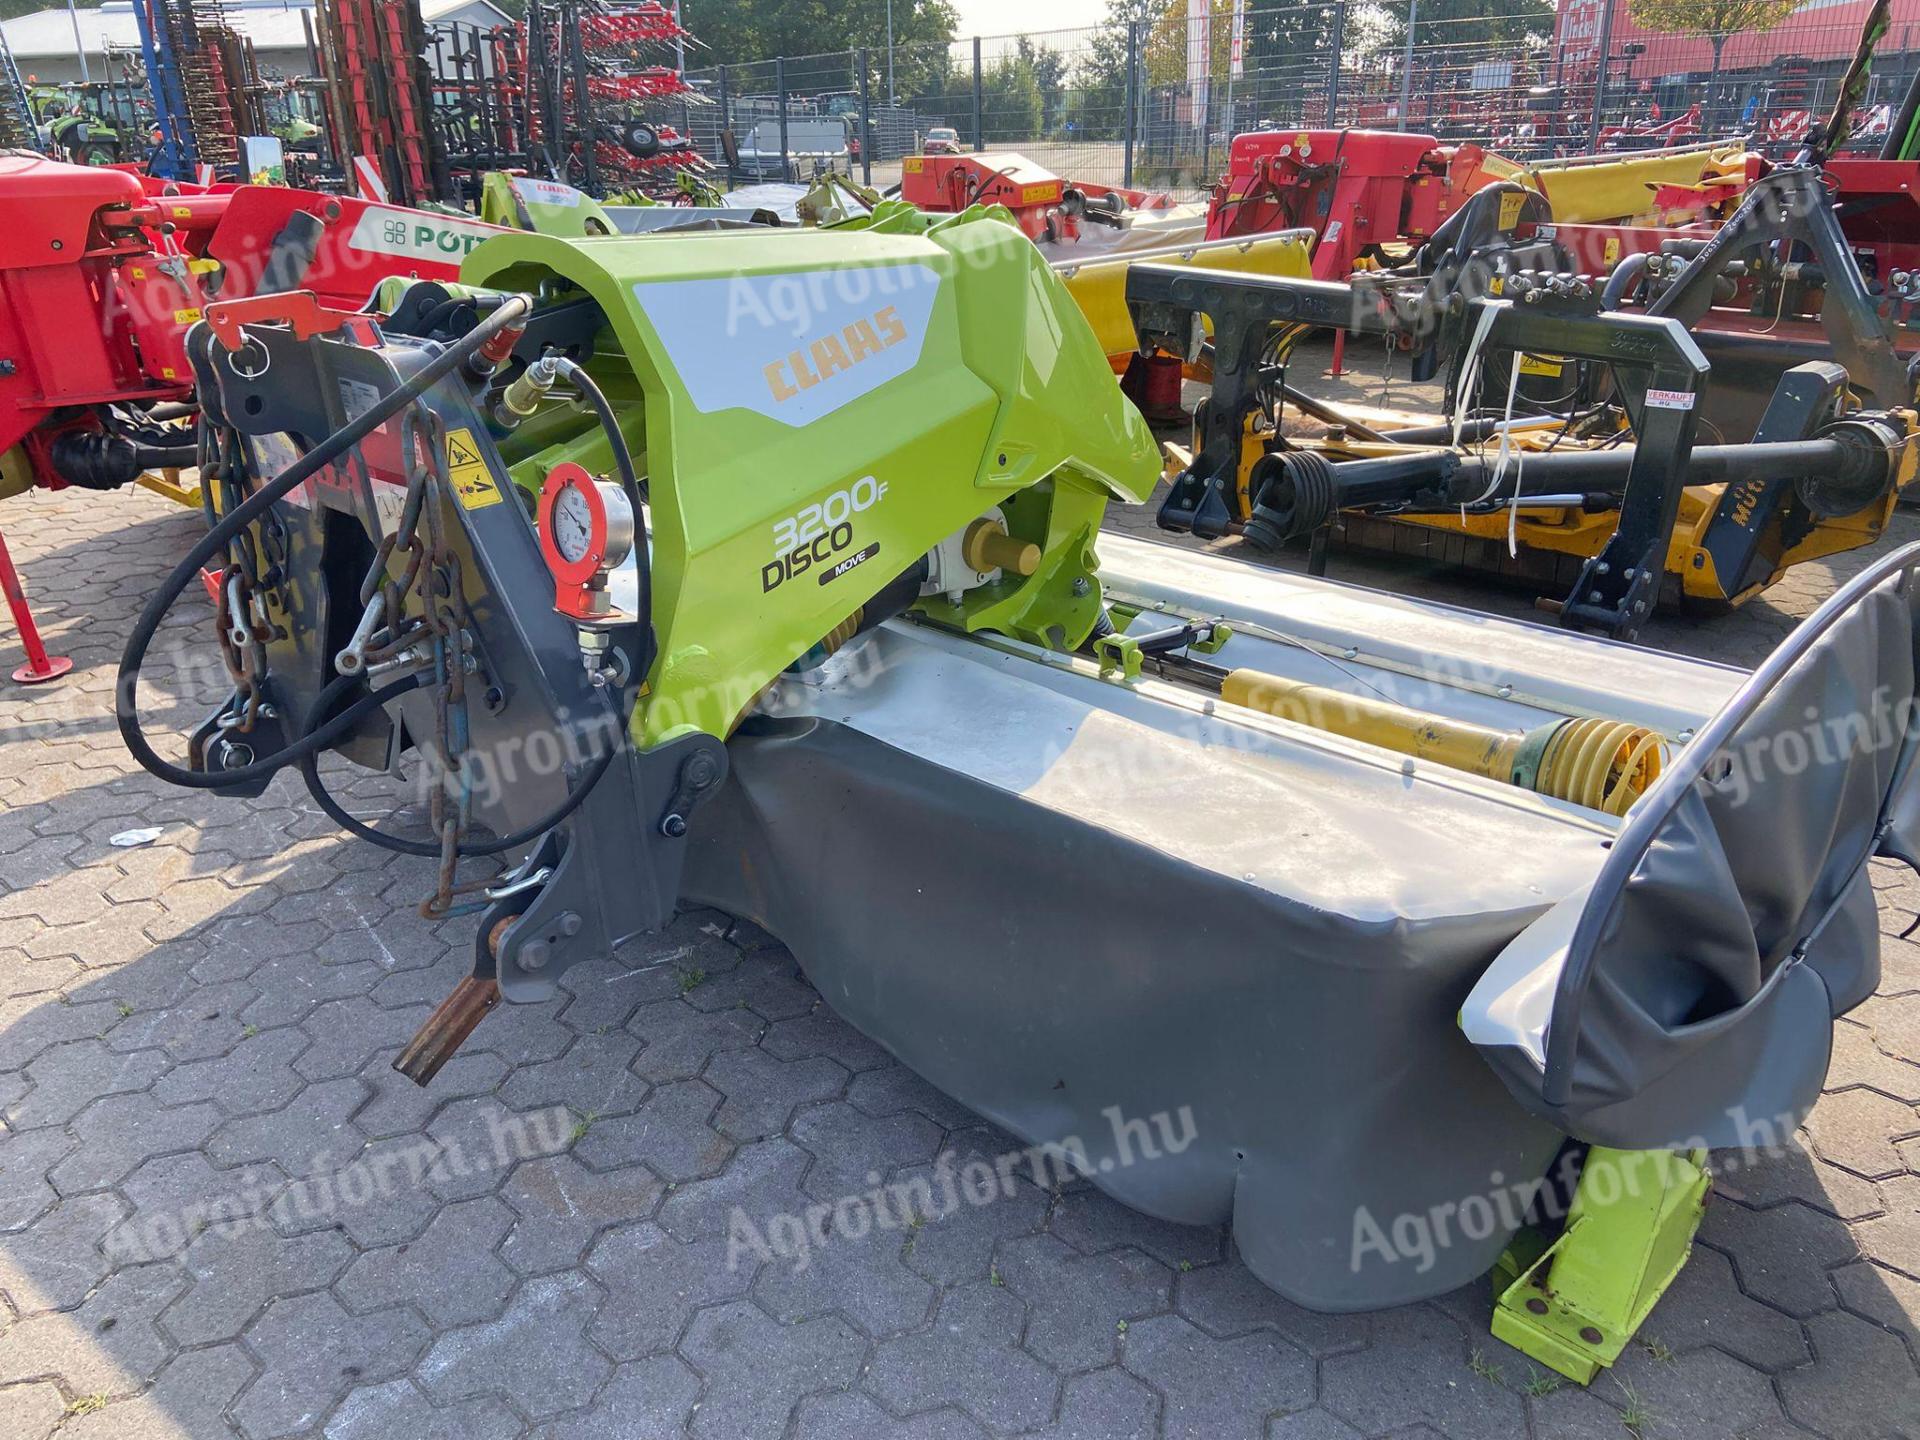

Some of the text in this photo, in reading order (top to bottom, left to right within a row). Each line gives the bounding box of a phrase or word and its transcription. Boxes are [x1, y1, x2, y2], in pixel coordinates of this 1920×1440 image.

[763, 304, 908, 403] CLAAS
[1647, 389, 1695, 402] VERKAUFT
[762, 521, 853, 593] DISCO
[835, 550, 866, 576] MOVE
